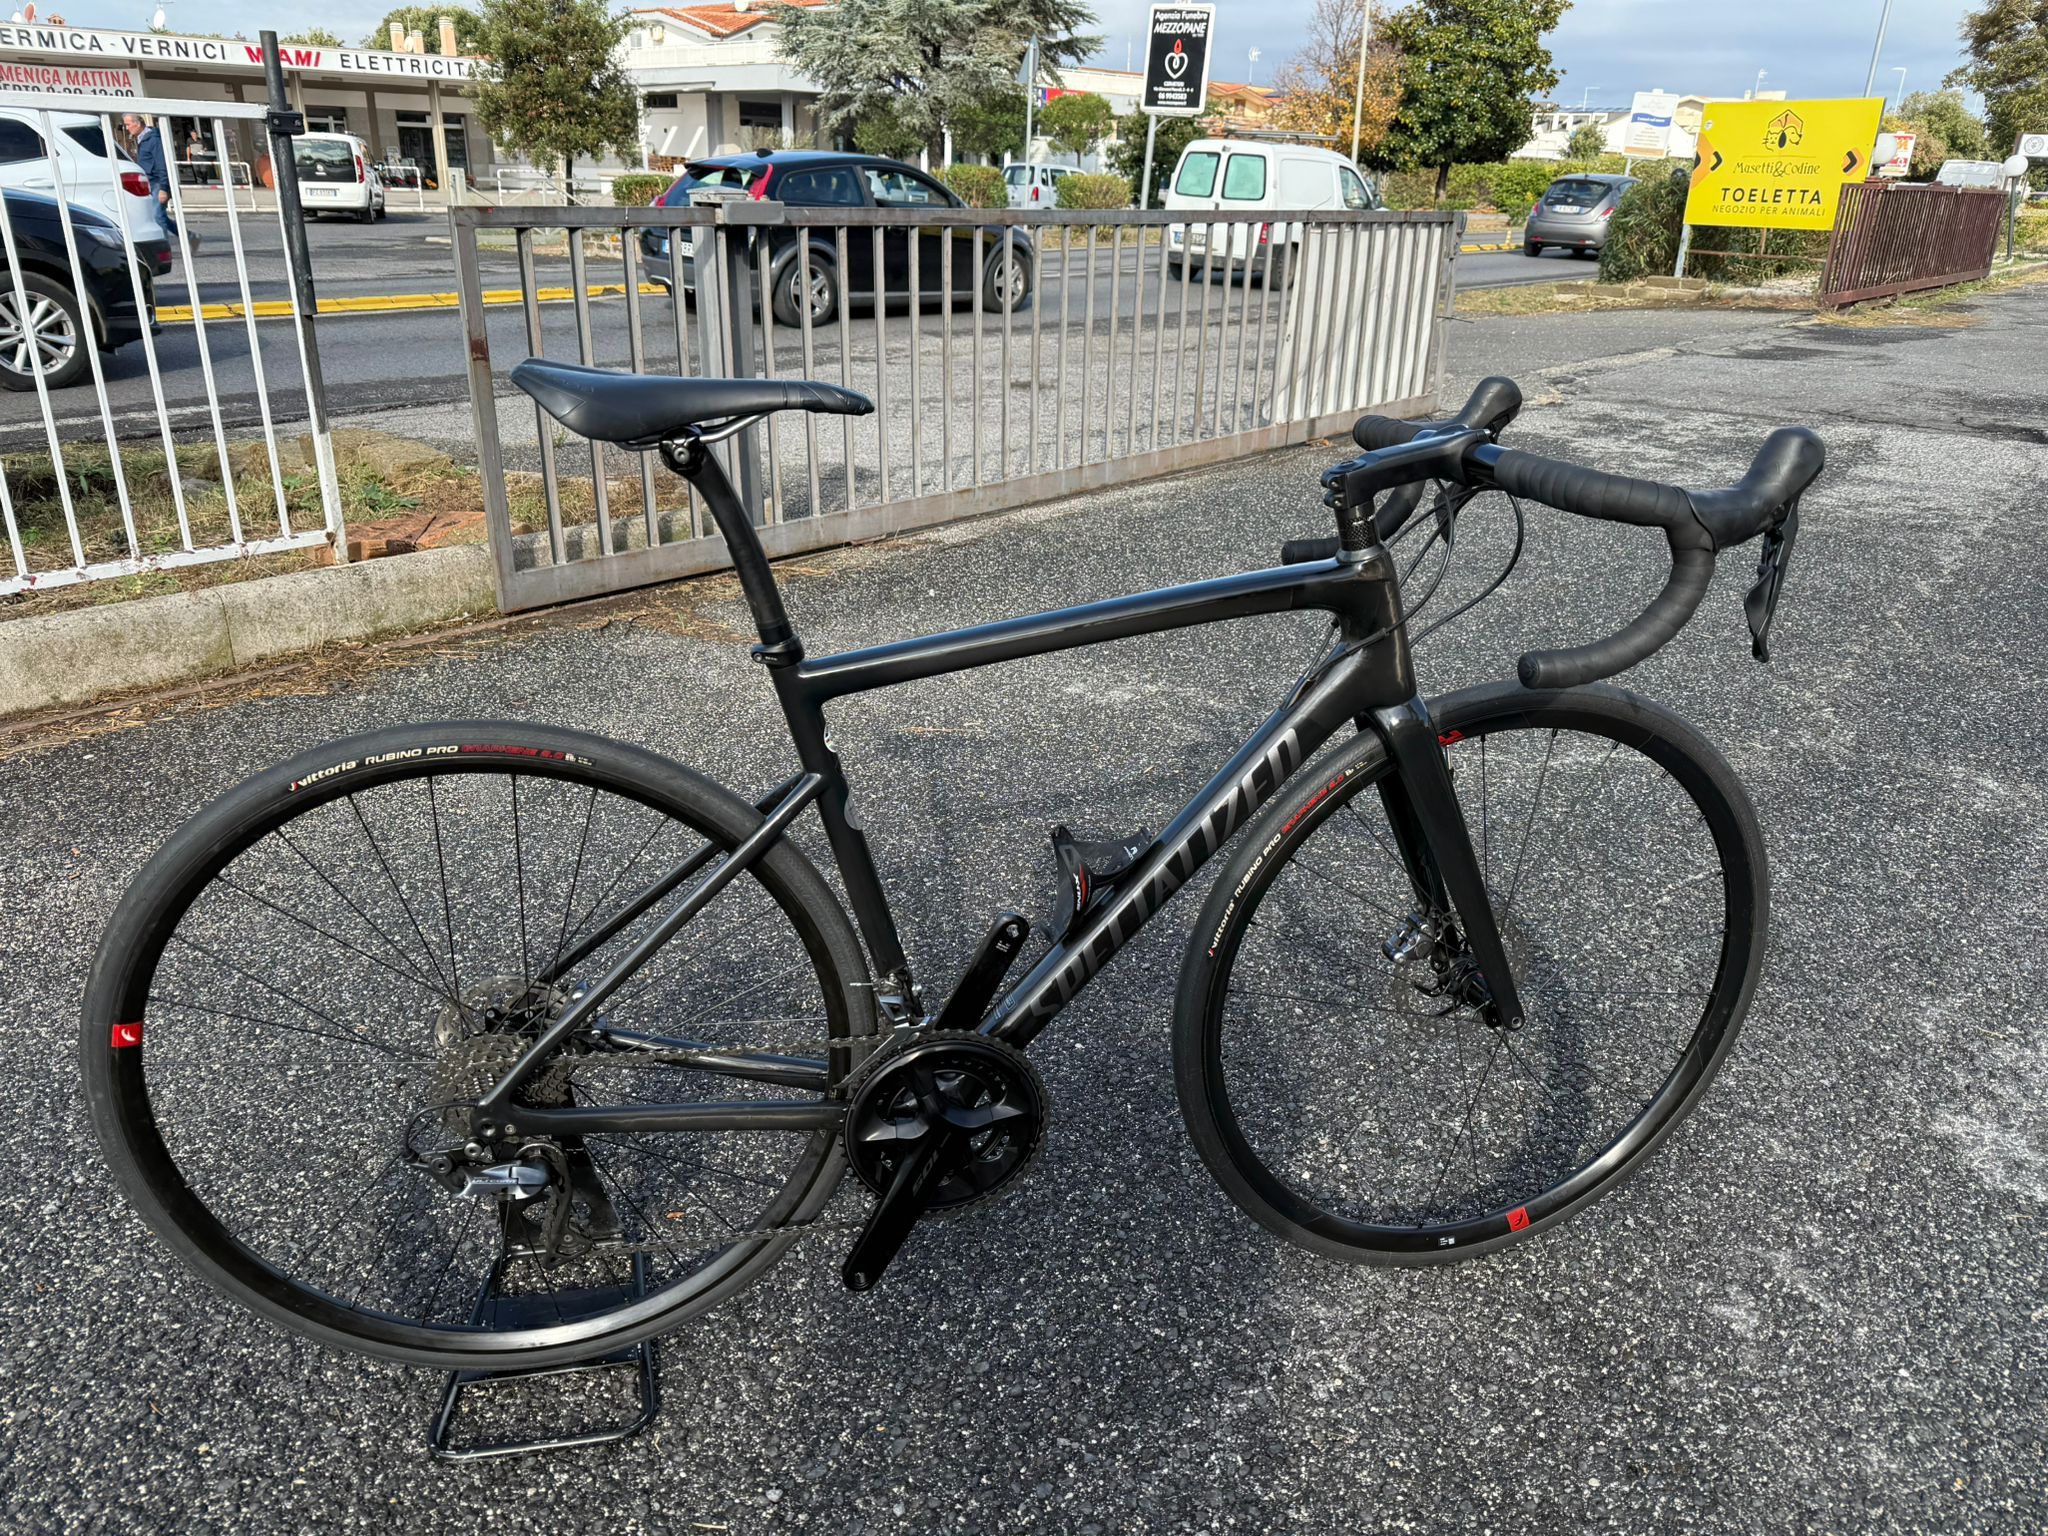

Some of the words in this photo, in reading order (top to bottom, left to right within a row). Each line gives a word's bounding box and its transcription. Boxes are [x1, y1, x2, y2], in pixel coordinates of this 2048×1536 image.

[1155, 11, 1181, 21] Agenzia
[1154, 22, 1207, 34] MEZZOPANE
[0, 28, 103, 51] ERMICA
[122, 36, 226, 60] VERNICI
[244, 46, 321, 67] MAMI
[66, 70, 132, 88] MATTINA
[1721, 188, 1821, 204] TOELETTA
[1712, 205, 1756, 214] NEGOZIO
[1760, 207, 1777, 215] PER
[1782, 208, 1825, 216] ANIMALI
[297, 760, 357, 787] vittoria
[365, 748, 422, 765] RUBINO
[426, 745, 458, 756] PRO
[1211, 901, 1235, 949] vittoria
[1234, 856, 1263, 898] RUBINO
[1262, 832, 1281, 857] PRO
